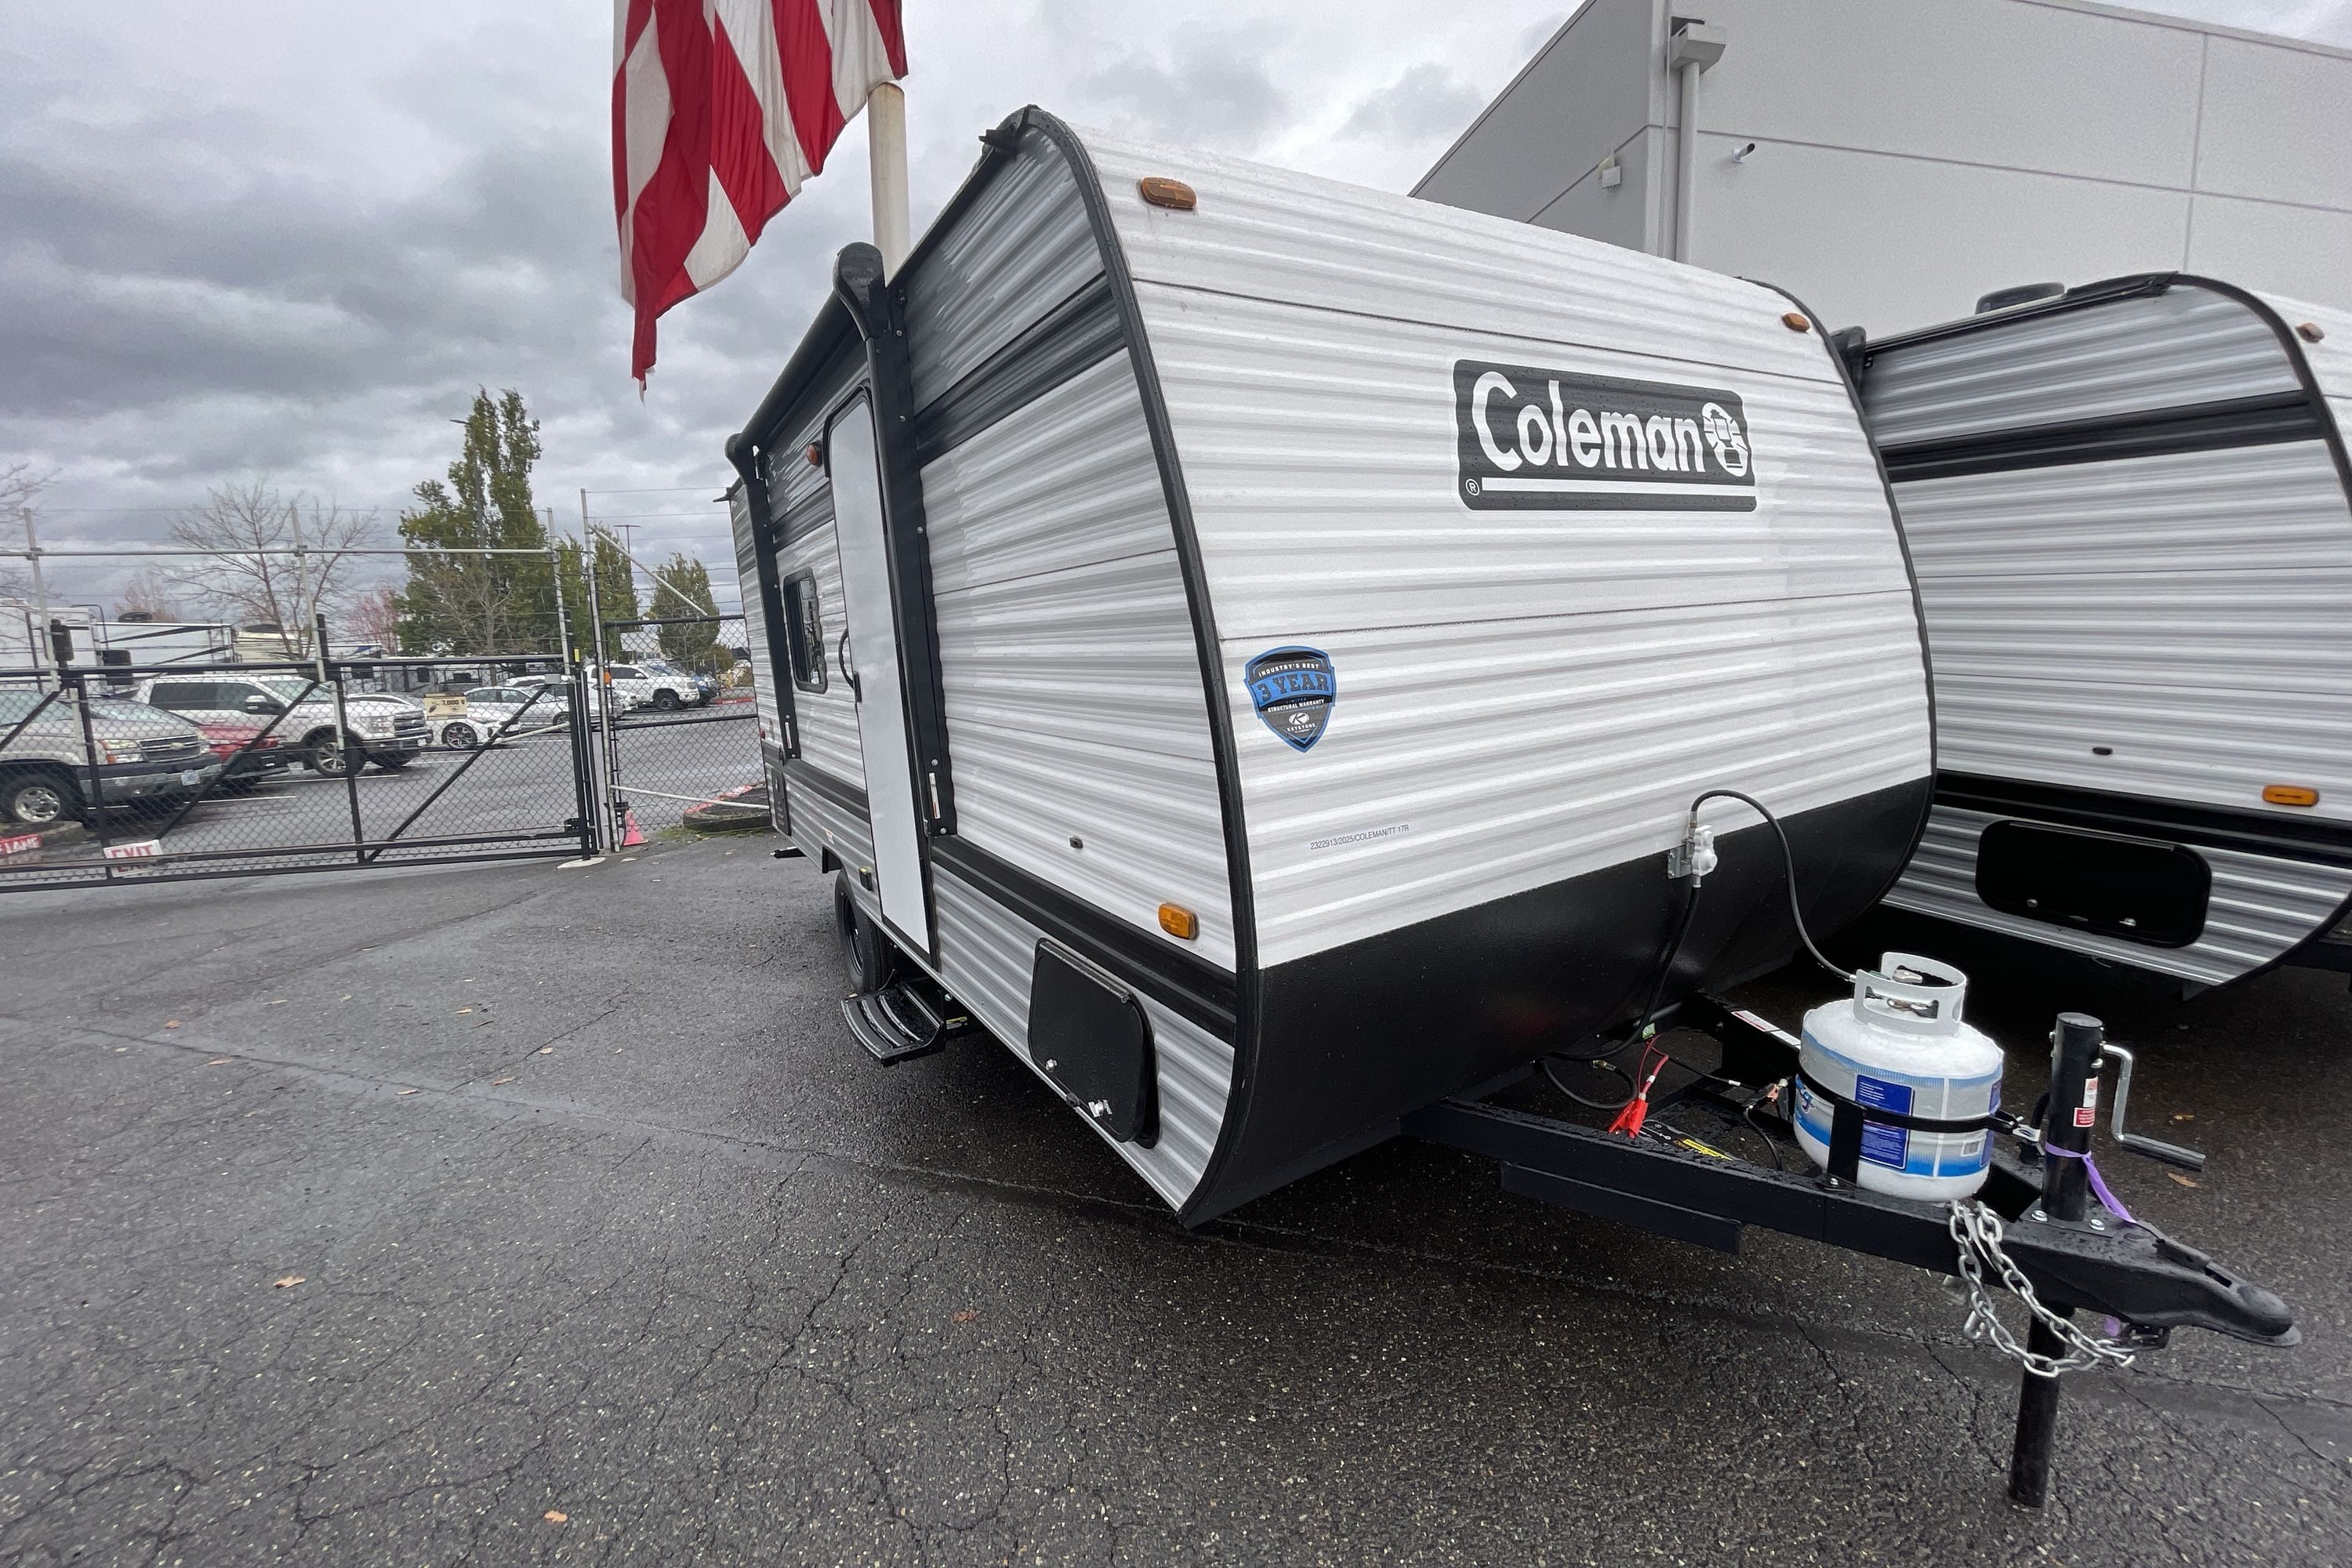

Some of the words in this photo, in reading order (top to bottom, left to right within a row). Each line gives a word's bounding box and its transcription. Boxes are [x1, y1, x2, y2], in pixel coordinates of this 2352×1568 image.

[1472, 371, 1706, 473] Coleman
[1258, 663, 1300, 677] INDUSTRY'S
[1257, 683, 1272, 702] 3
[1272, 673, 1329, 694] YEAR
[1267, 703, 1298, 713] STRUCTURAL
[1298, 699, 1325, 707] WARRANTY
[1287, 723, 1316, 732] KEYSTONE
